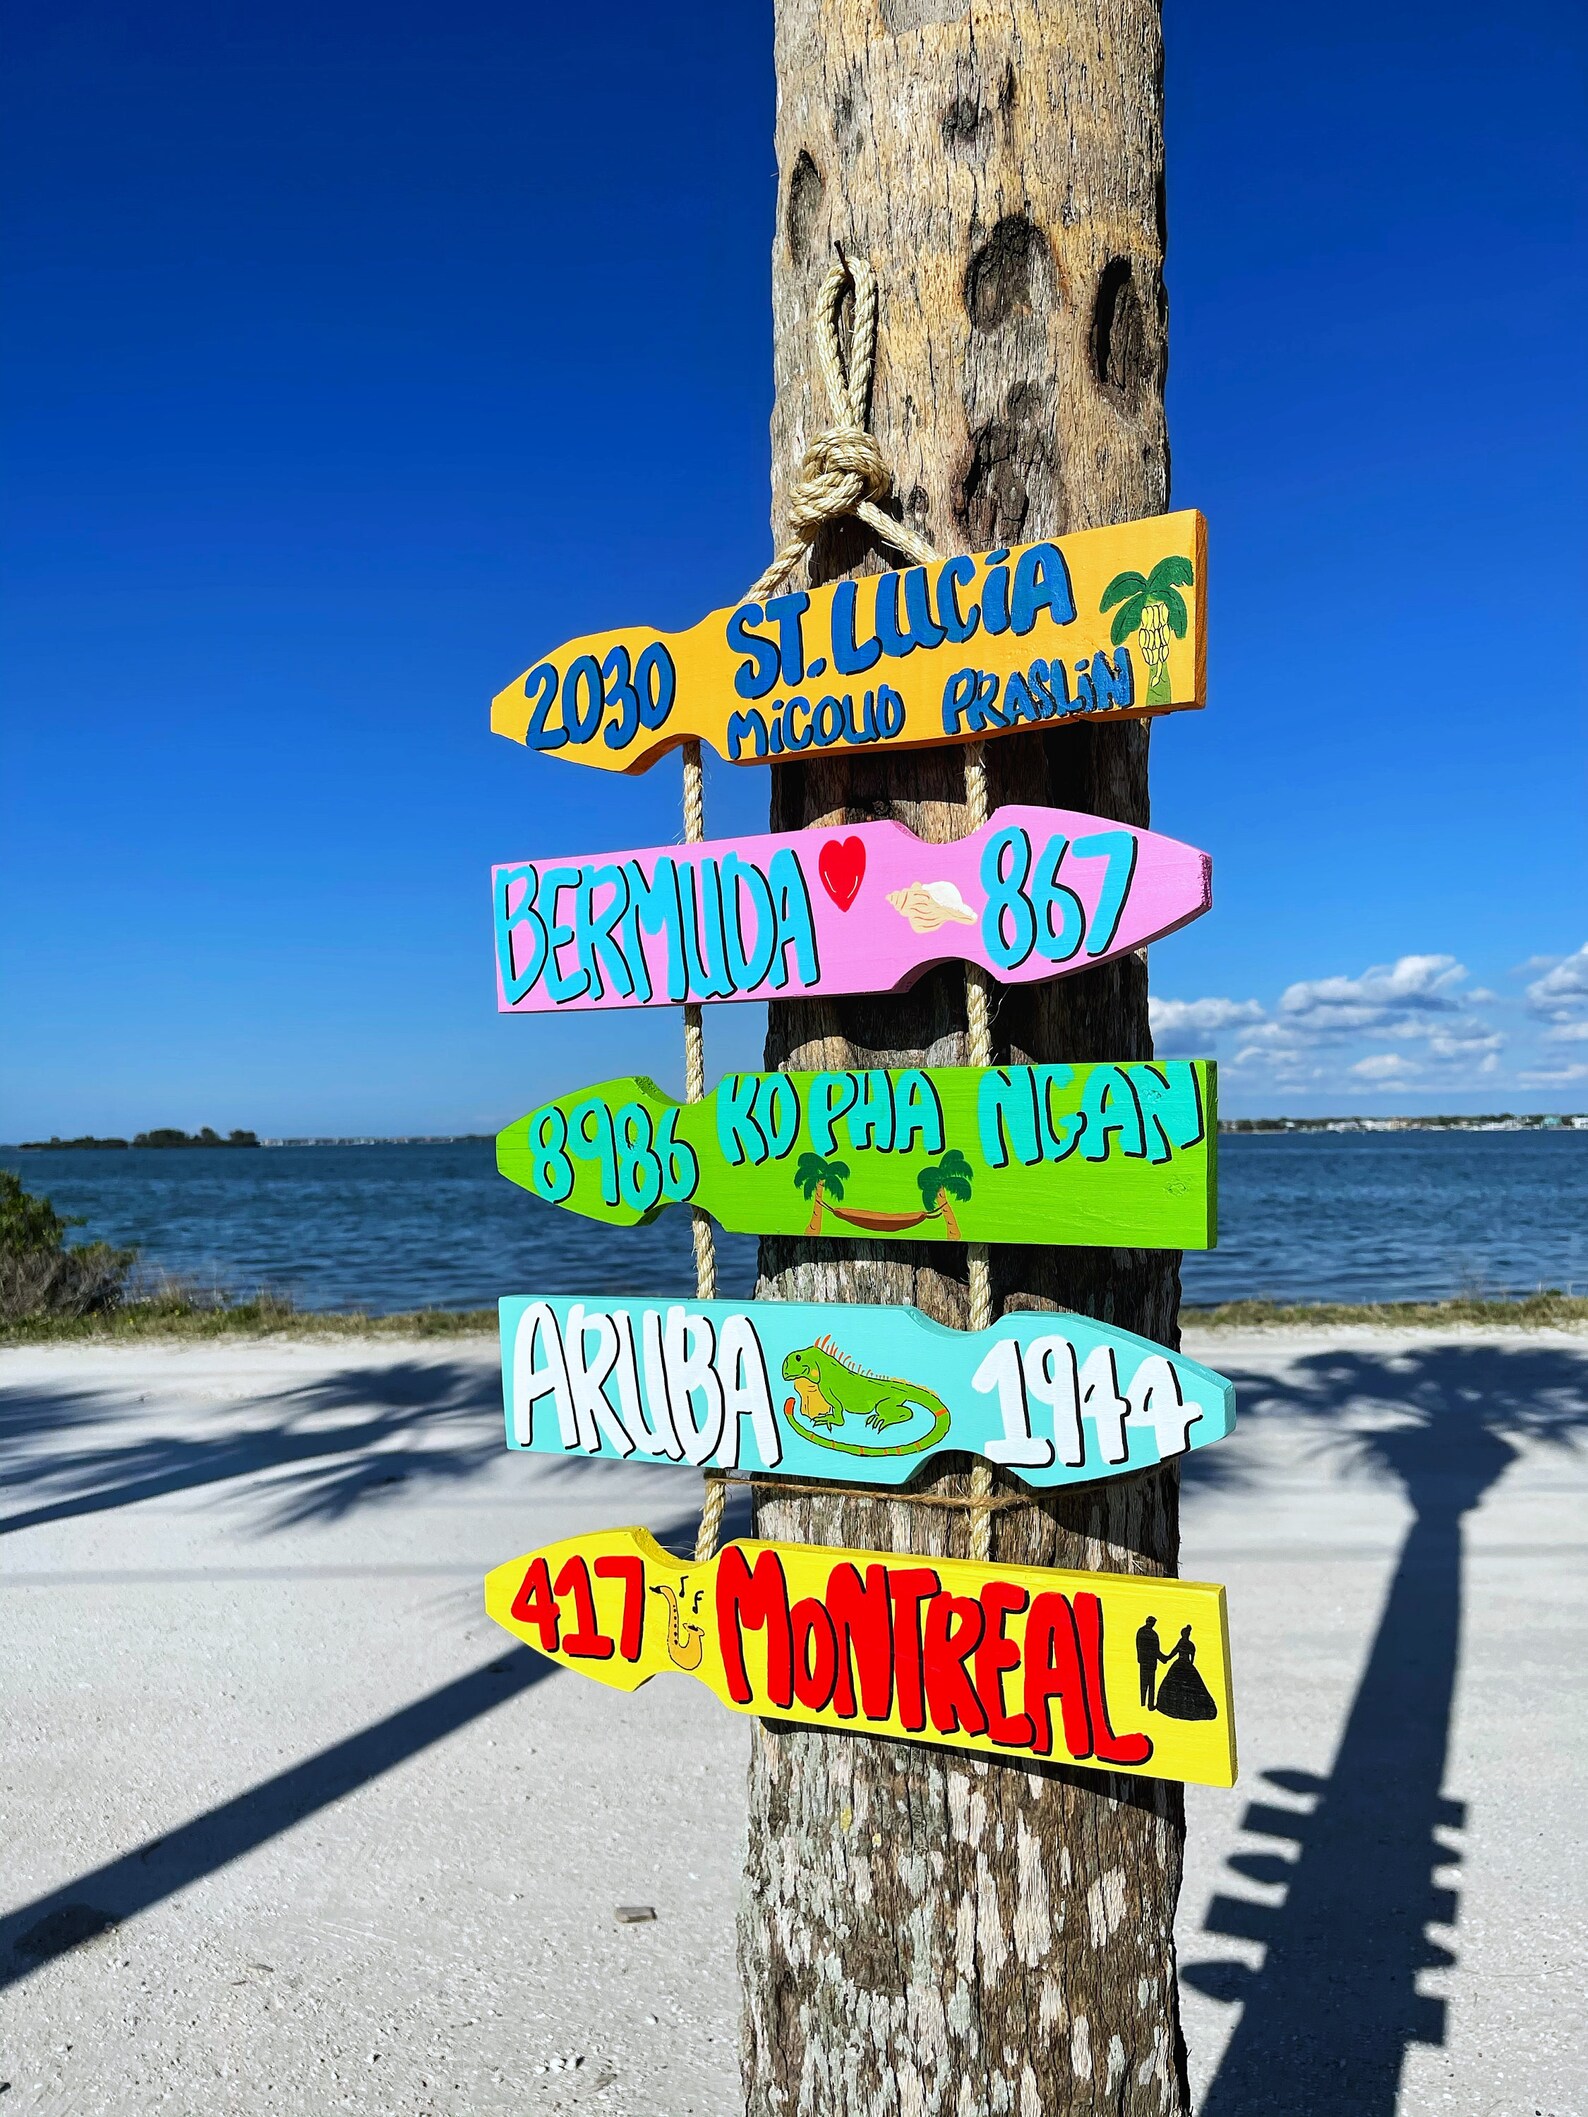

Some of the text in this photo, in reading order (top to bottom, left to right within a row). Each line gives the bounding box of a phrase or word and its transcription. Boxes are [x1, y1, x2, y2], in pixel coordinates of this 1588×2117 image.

[523, 643, 677, 753] 2030
[493, 826, 1139, 1006] BERMUDA 867
[527, 1060, 1206, 1214] 8986 KO PHA NGAN
[511, 1303, 1204, 1470] ARUBA 1944
[510, 1555, 645, 1662] 417
